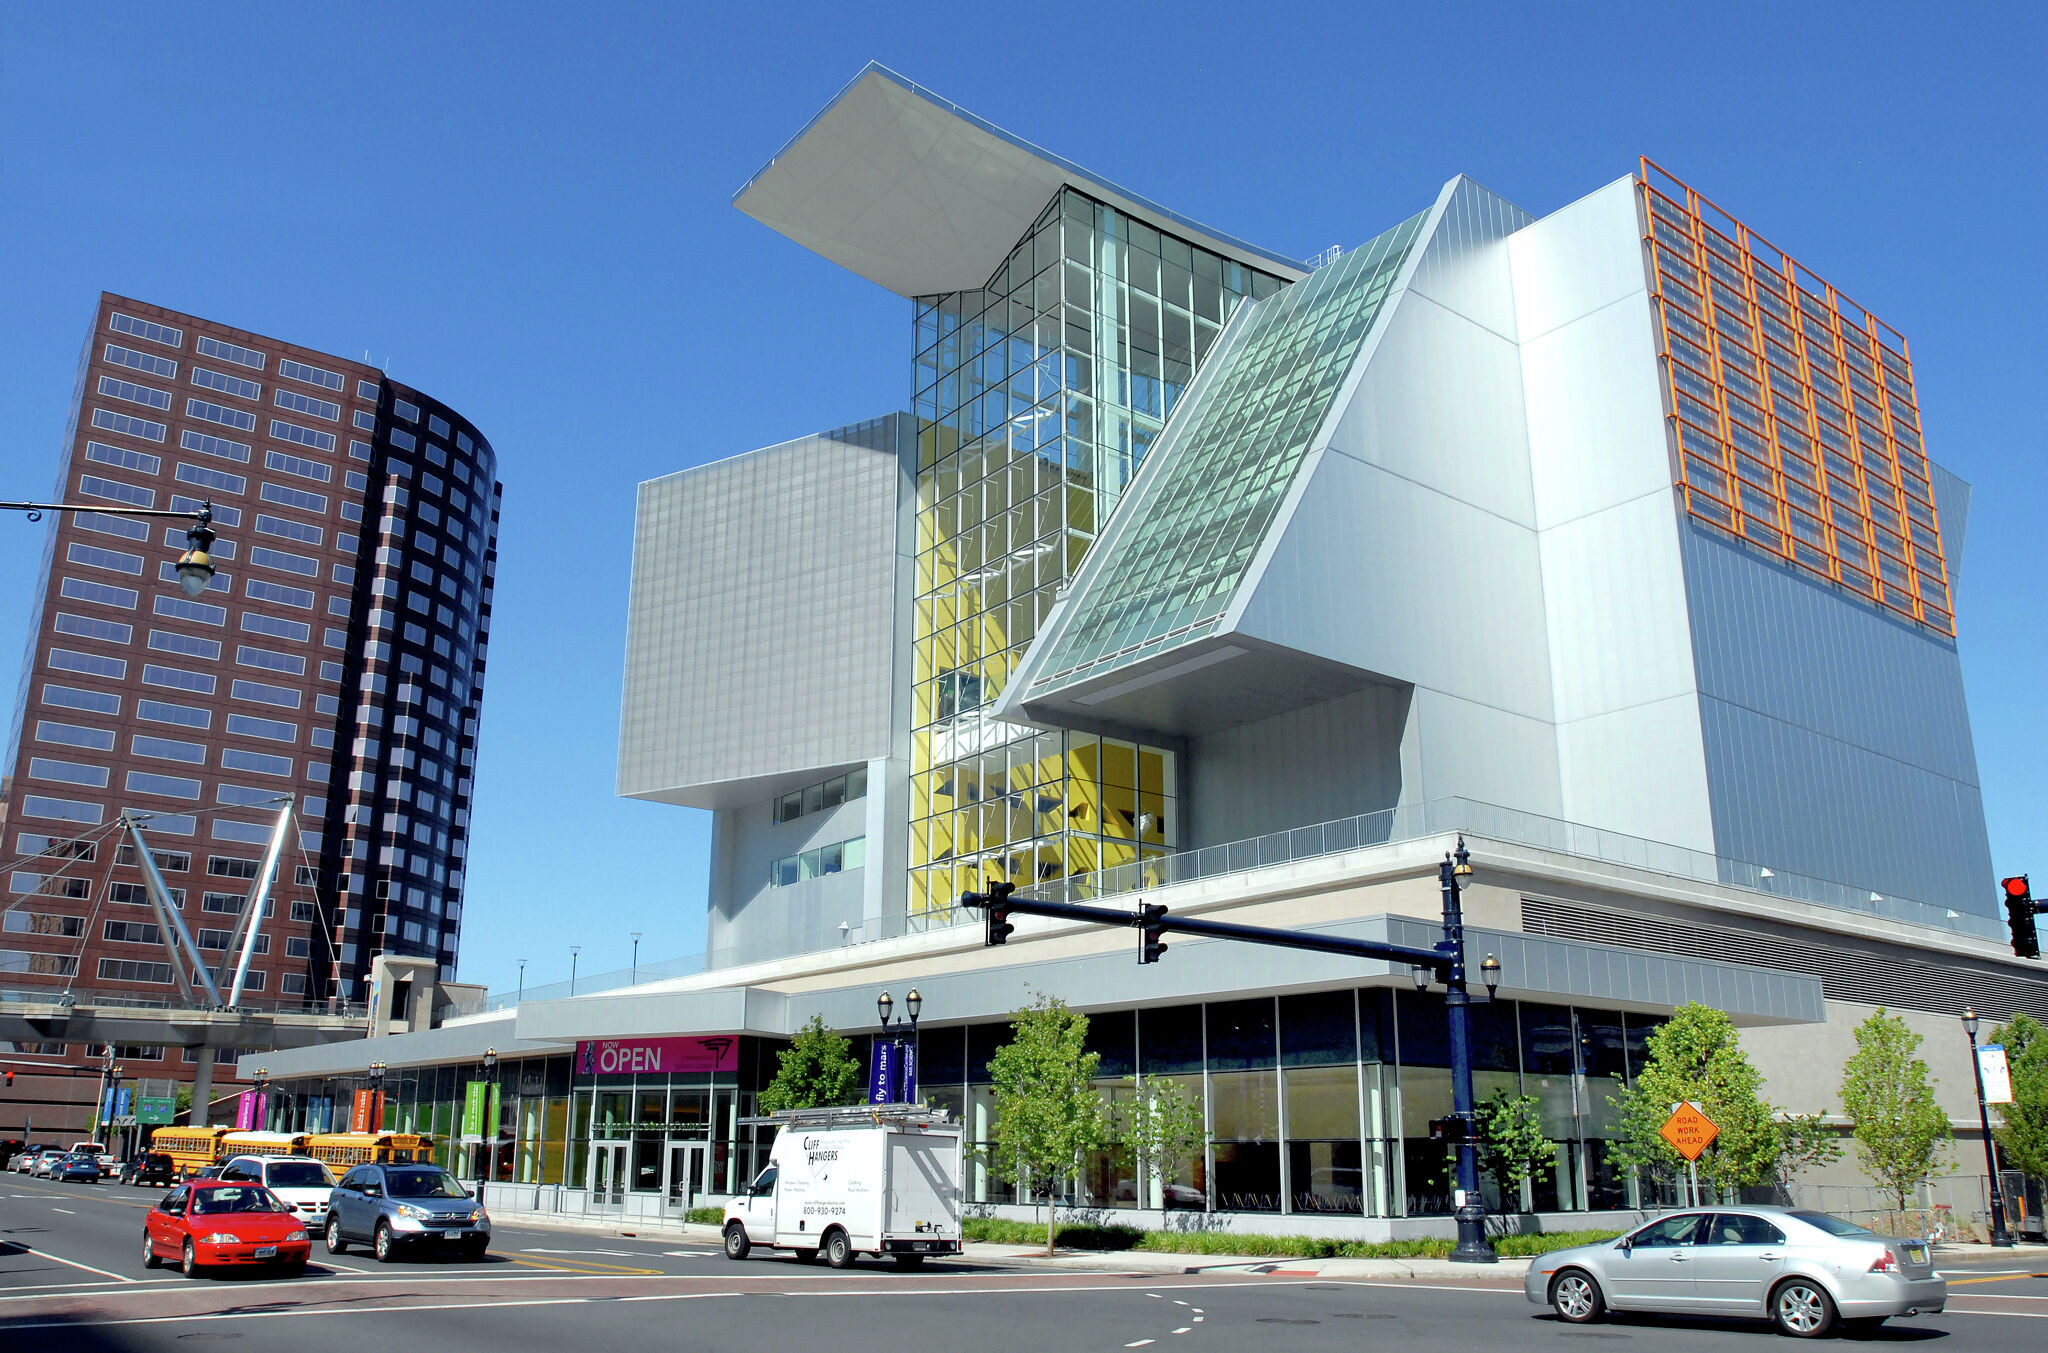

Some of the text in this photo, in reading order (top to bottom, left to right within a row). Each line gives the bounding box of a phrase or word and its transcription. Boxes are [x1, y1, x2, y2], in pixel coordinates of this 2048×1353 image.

[602, 1041, 620, 1049] NOW
[600, 1047, 662, 1072] OPEN
[878, 1073, 886, 1085] to
[875, 1087, 887, 1101] fly
[469, 1121, 474, 1130] be
[1676, 1116, 1698, 1125] ROAD
[1677, 1126, 1700, 1135] WORK
[803, 1136, 820, 1150] CLIFF
[1676, 1136, 1703, 1144] AHEAD
[808, 1151, 838, 1165] HANGERS
[803, 1206, 846, 1216] 800-930-9274
